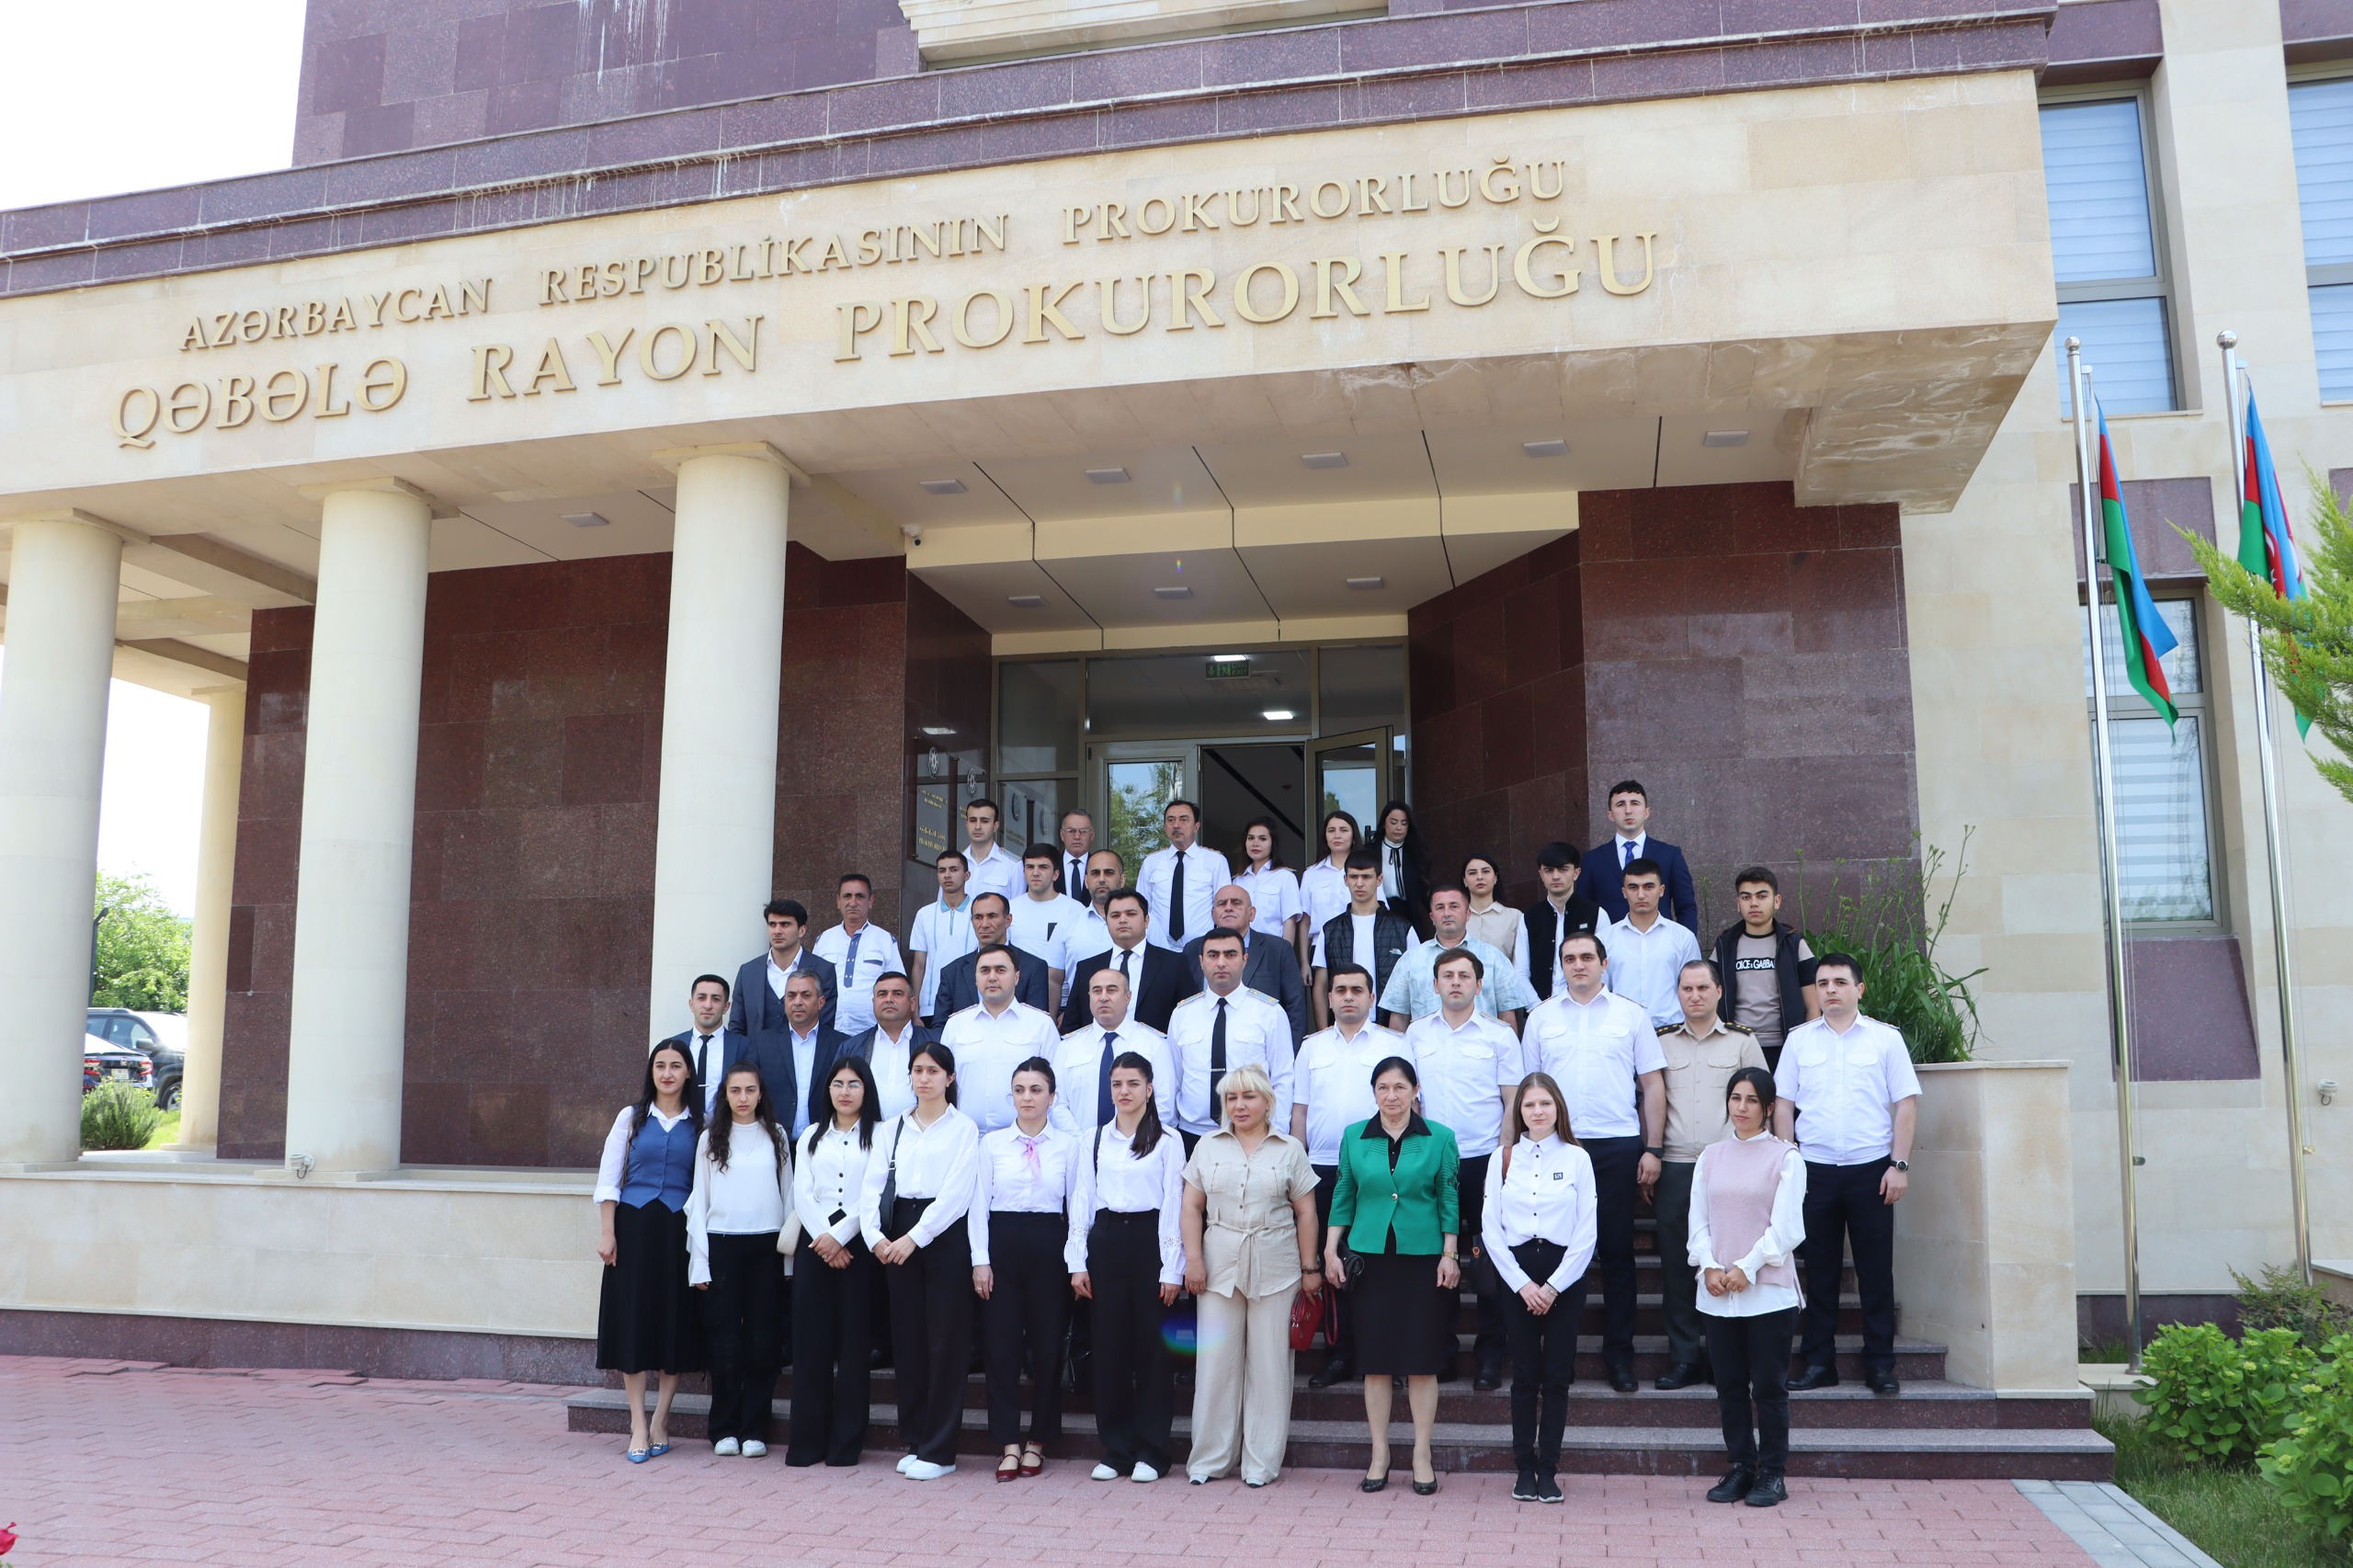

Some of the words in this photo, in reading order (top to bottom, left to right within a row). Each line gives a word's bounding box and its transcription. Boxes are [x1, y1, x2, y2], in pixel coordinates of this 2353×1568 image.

[111, 355, 408, 449] QƏBƏLƏ
[467, 314, 764, 402] RAYON
[835, 216, 1657, 363] PROKURORLUĞU
[179, 277, 492, 351] AZƏRBAYCAN
[539, 212, 1009, 305] RESPUBLİKASININ
[1063, 155, 1566, 244] PROKURORLUĞU
